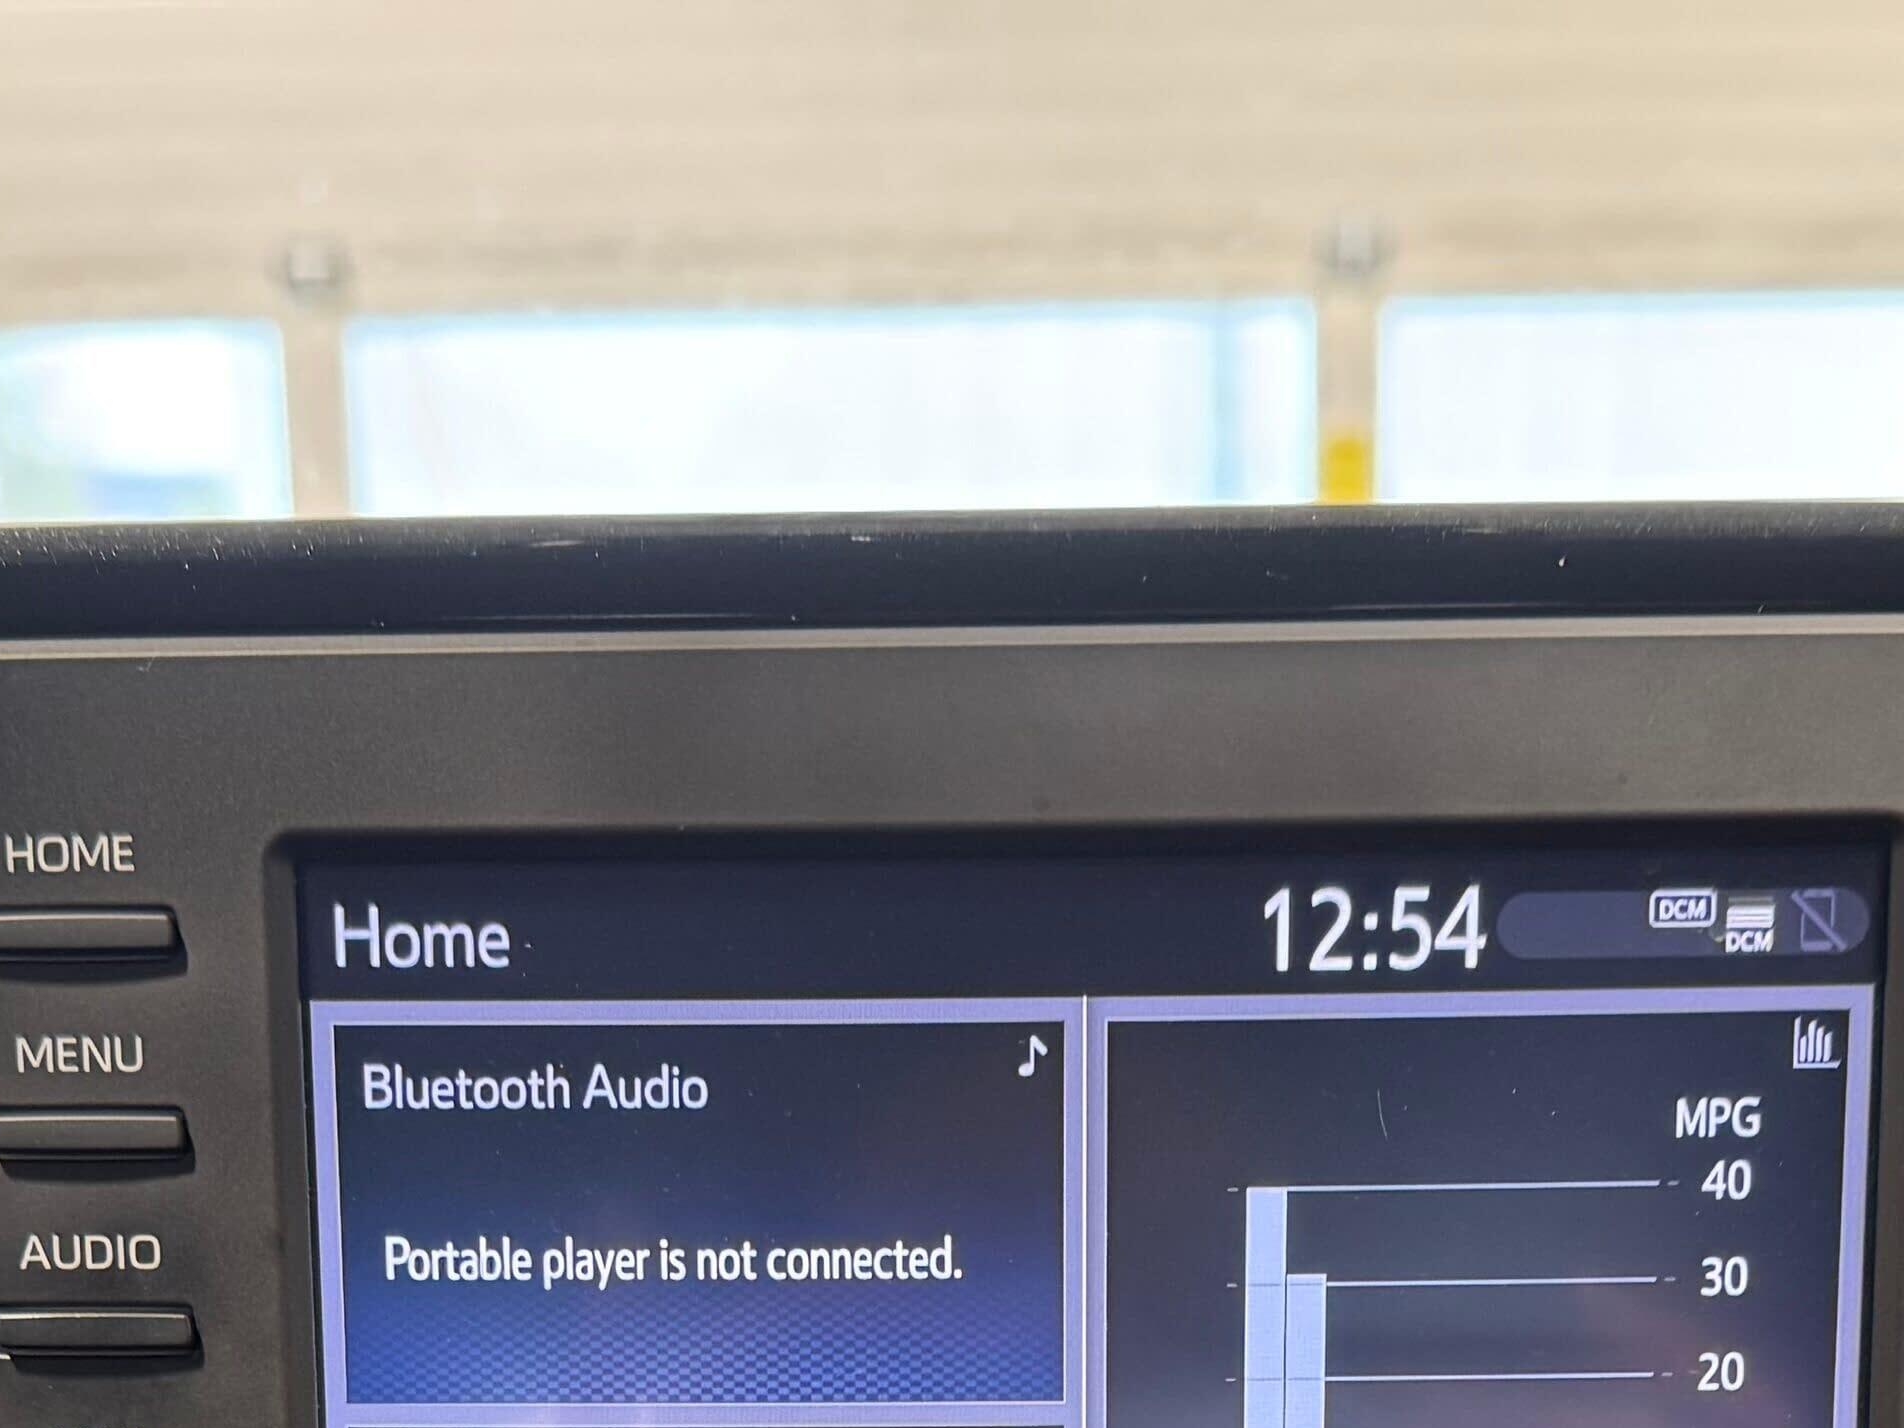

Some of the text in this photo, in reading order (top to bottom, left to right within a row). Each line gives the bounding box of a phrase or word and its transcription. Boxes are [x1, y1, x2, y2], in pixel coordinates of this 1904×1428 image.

[5, 834, 135, 874] HOME
[1264, 884, 1488, 972] 12:54
[1659, 897, 1707, 921] DCM
[333, 903, 510, 969] Home
[1725, 931, 1774, 953] DCM
[15, 1034, 144, 1073] MENU
[363, 1062, 709, 1110] Bluetooth Audio
[1675, 1096, 1762, 1139] MPG
[1701, 1158, 1752, 1201] 40
[19, 1234, 161, 1270] AUDIO
[384, 1234, 963, 1292] Portable player is not connected.
[1700, 1255, 1749, 1297] 30
[1697, 1351, 1745, 1391] 20
